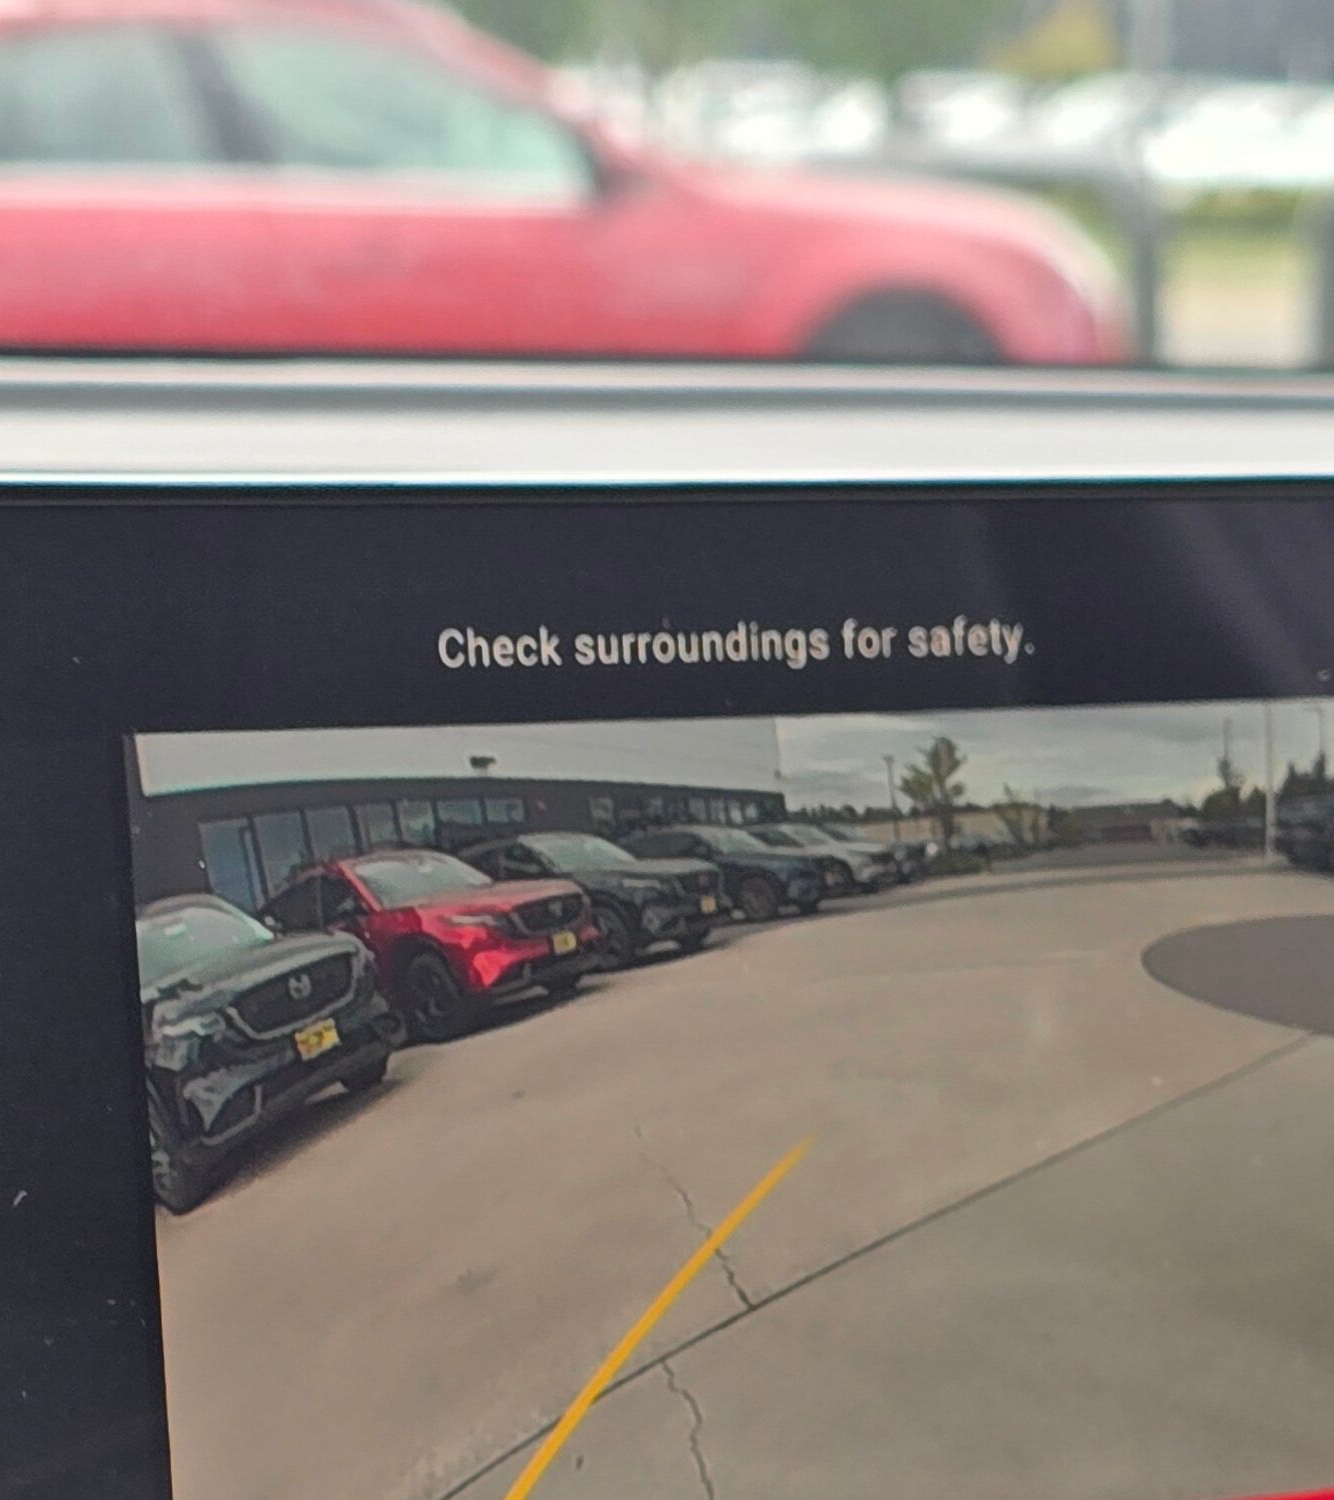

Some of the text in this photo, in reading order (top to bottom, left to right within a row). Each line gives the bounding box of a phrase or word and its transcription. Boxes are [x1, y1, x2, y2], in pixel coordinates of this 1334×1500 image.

[437, 613, 1036, 671] Check surroundings for safety.
